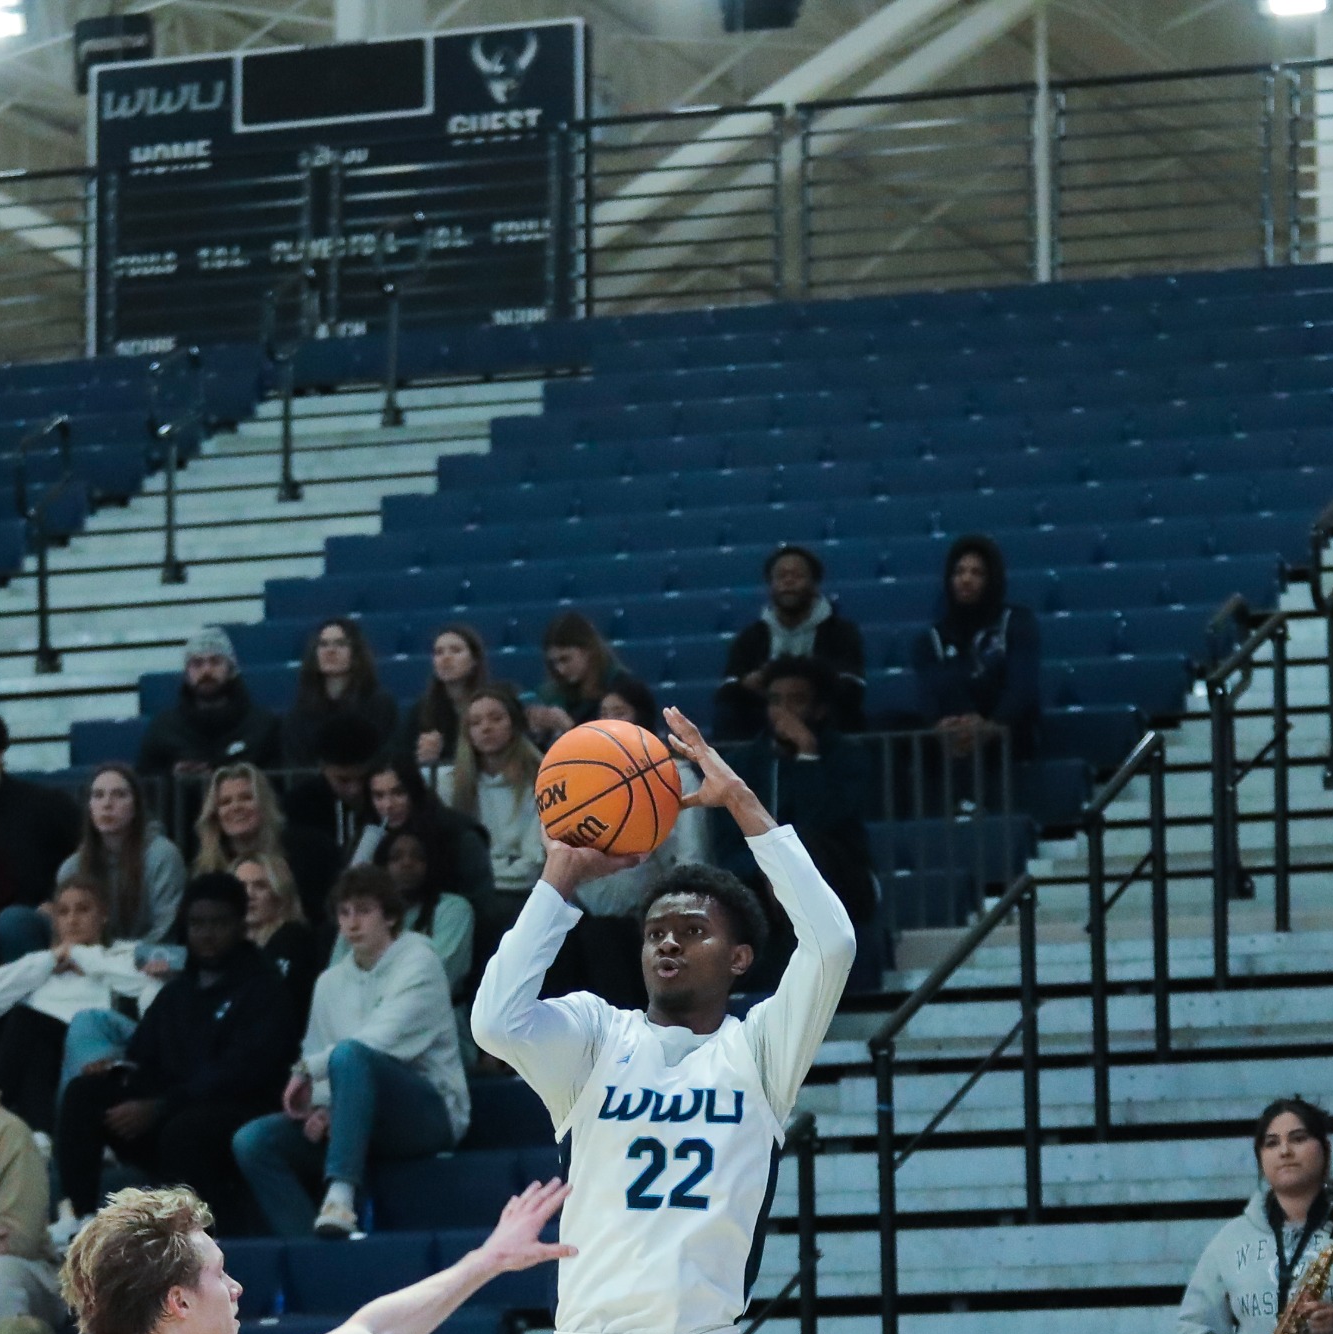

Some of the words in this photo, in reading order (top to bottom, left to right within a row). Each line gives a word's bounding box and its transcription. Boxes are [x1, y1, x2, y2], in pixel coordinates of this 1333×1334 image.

[103, 80, 226, 120] WWU
[598, 1085, 744, 1124] WWU
[625, 1136, 715, 1211] 22
